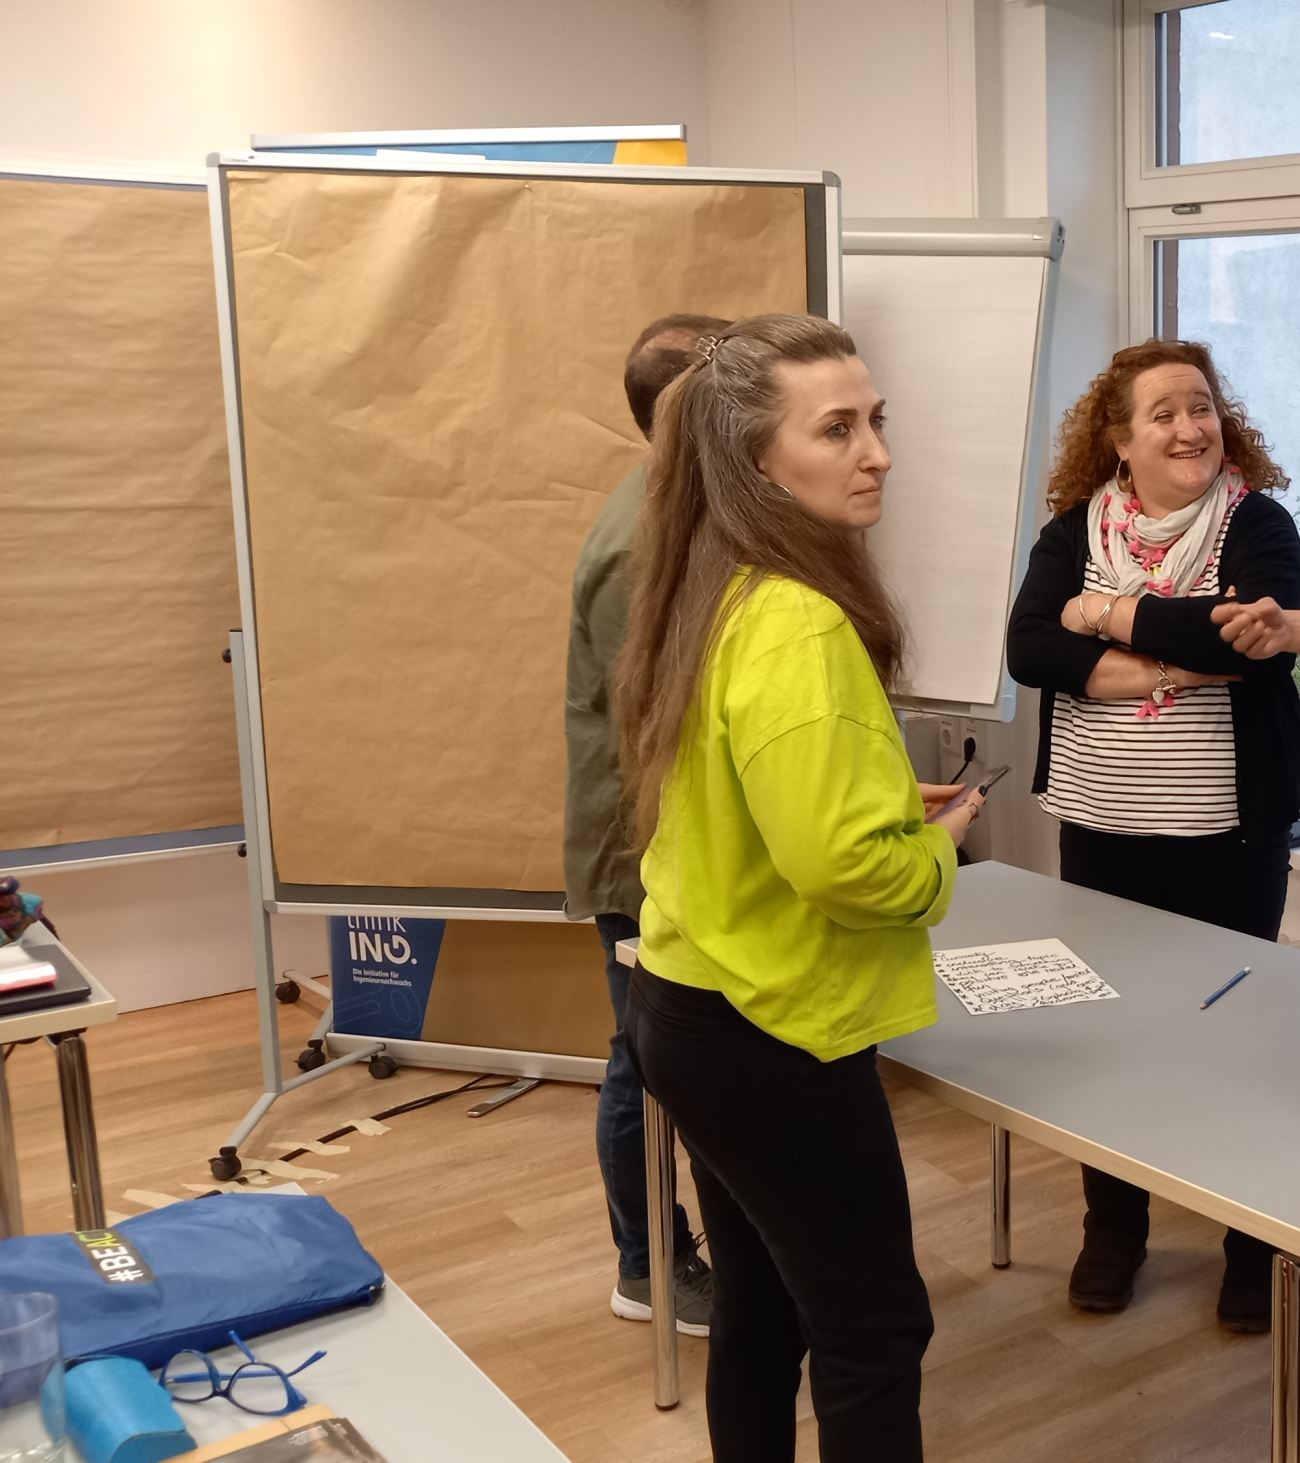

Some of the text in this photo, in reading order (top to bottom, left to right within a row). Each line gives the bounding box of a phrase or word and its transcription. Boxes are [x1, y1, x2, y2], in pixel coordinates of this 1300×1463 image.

[363, 969, 390, 978] Initiative
[390, 970, 400, 979] für
[353, 975, 412, 987] Ingenieurnachwuchs
